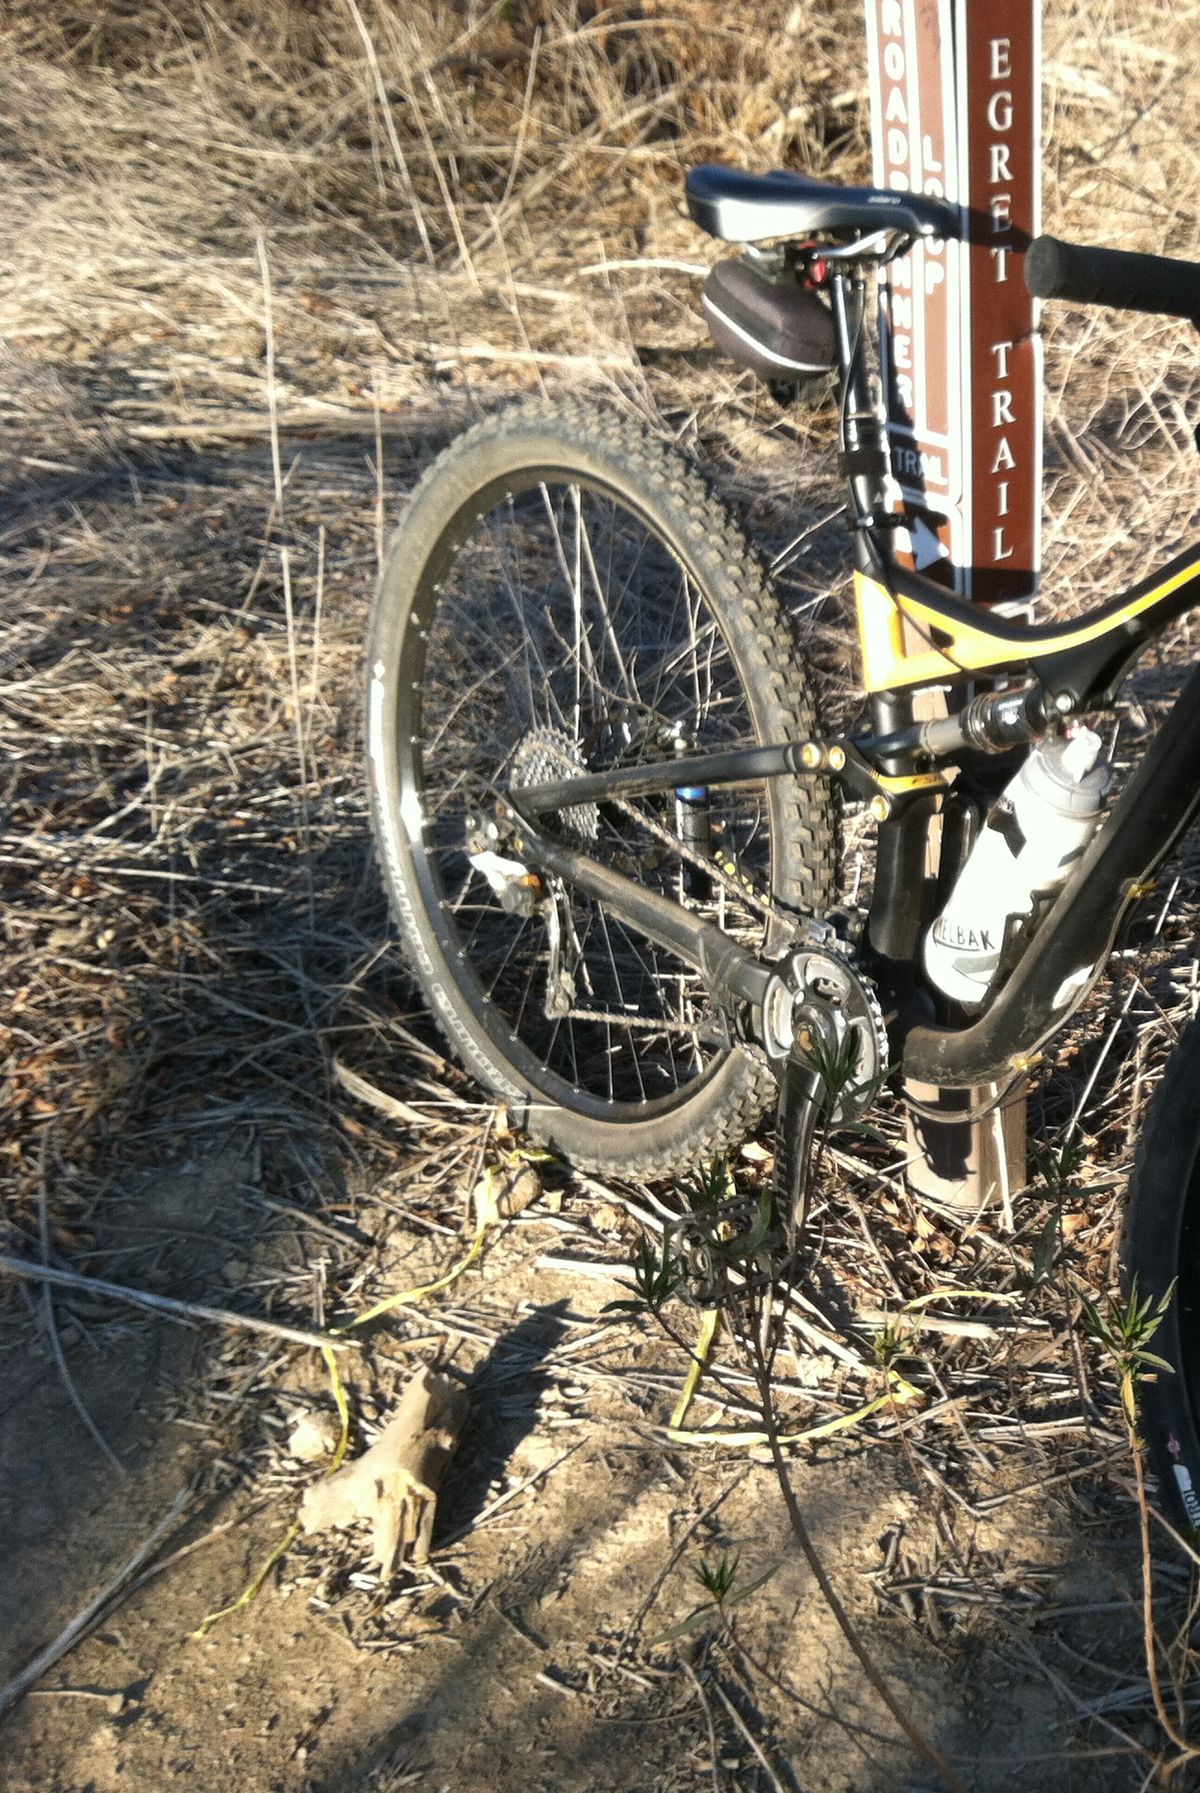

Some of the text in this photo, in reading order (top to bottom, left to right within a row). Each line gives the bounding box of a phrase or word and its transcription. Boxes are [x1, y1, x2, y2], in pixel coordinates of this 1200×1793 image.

[987, 38, 1017, 562] EGRET TRAIL
[895, 446, 949, 486] TRAIL
